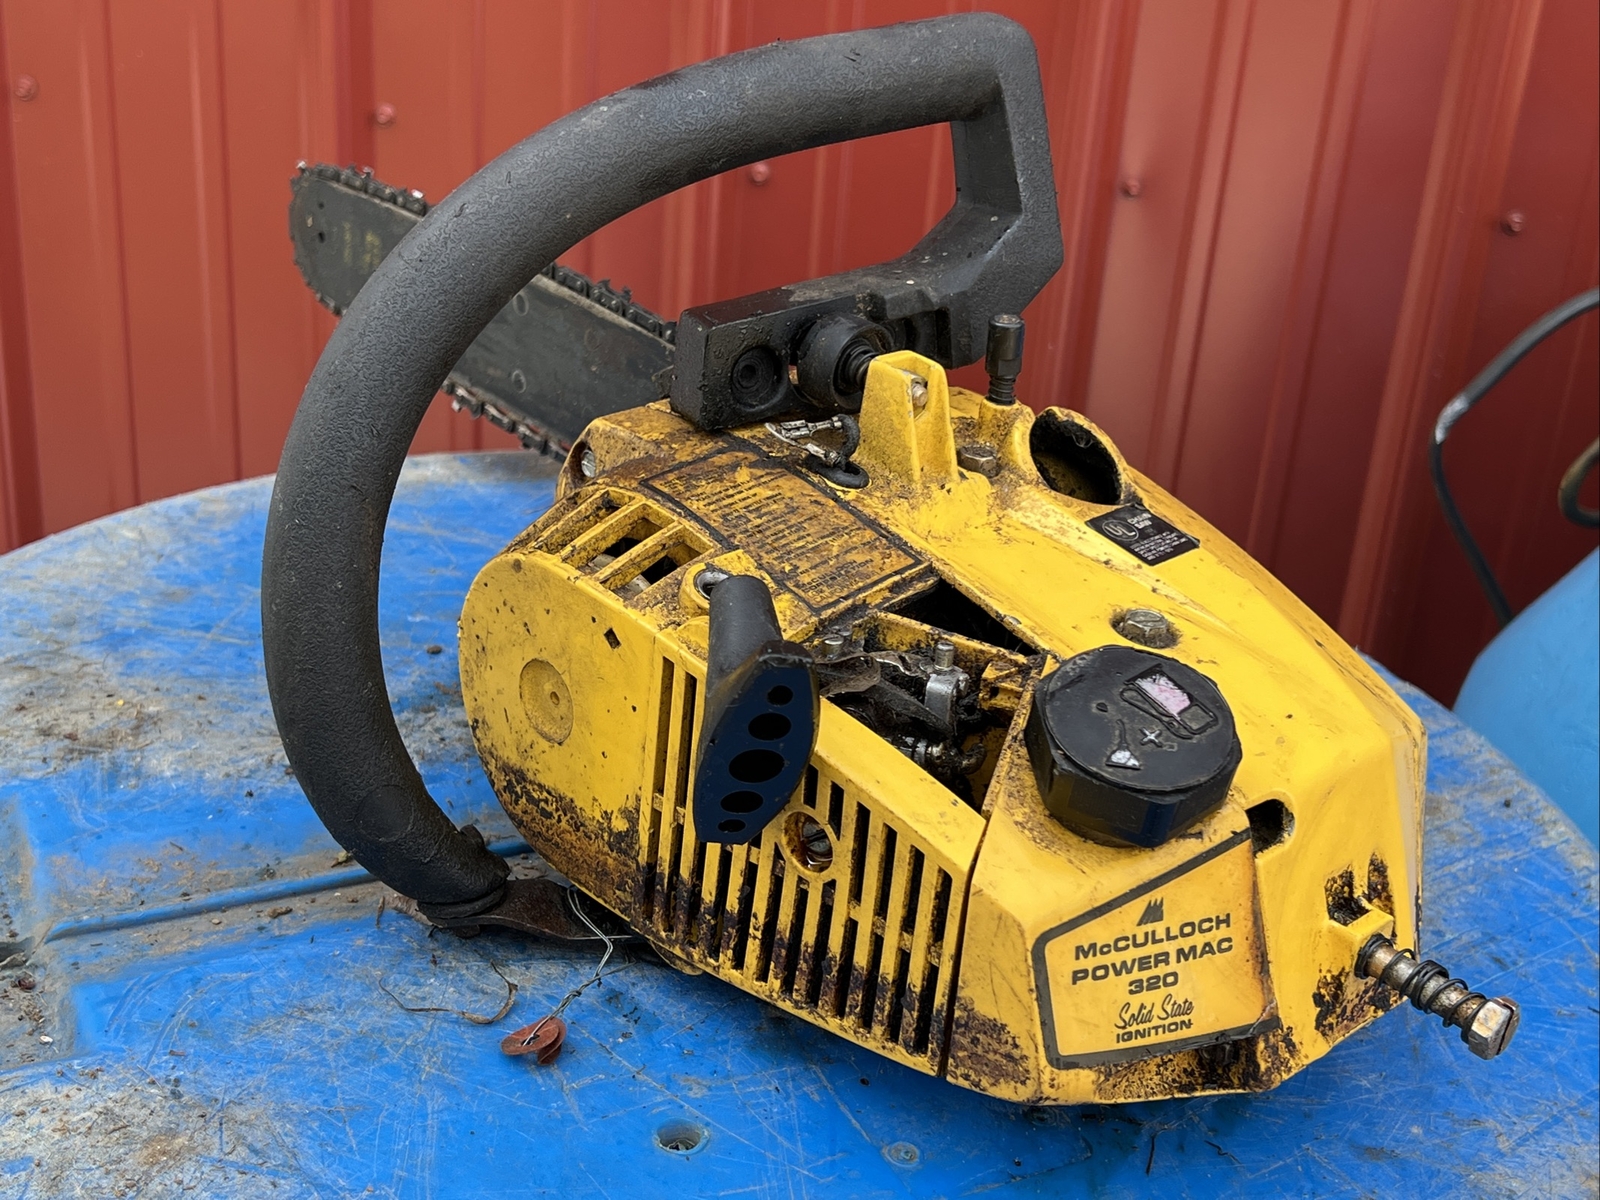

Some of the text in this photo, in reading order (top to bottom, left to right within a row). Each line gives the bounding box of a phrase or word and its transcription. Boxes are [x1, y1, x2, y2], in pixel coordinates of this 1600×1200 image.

[1074, 913, 1231, 960] McCULLOCH
[1072, 937, 1233, 985] POWER MAC
[1128, 971, 1179, 995] 320
[1114, 993, 1194, 1030] Solid State
[1116, 1019, 1192, 1043] IGNITION
